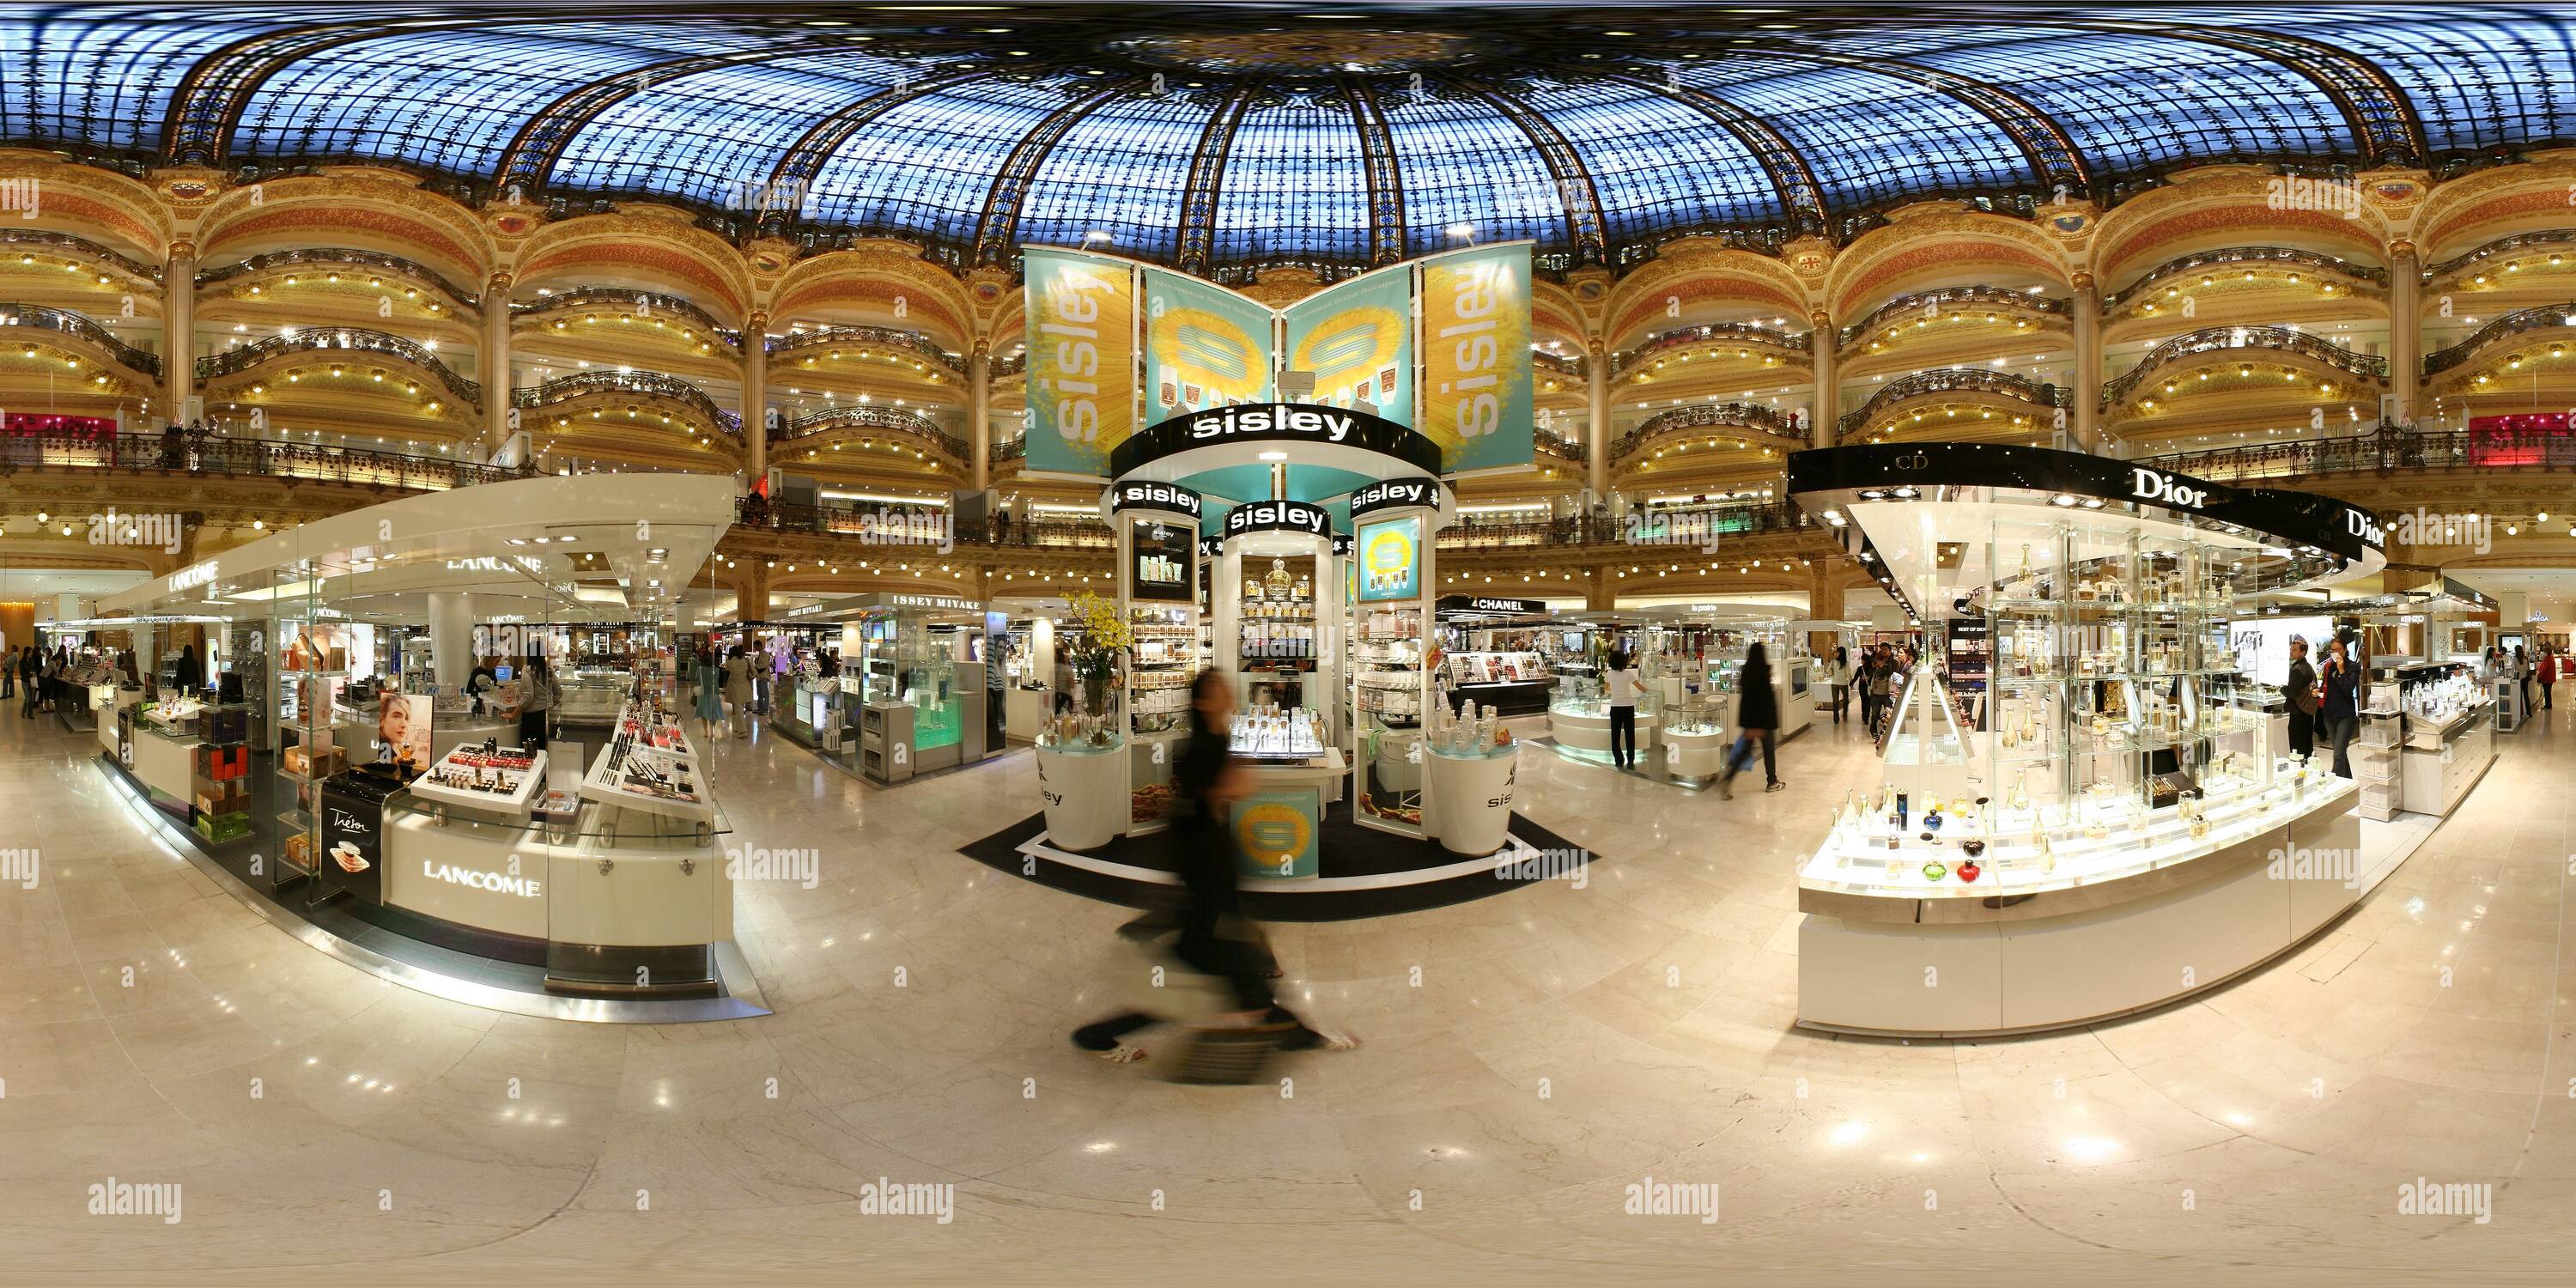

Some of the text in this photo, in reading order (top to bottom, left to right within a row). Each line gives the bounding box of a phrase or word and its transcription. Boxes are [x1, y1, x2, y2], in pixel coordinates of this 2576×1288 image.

[1041, 266, 1115, 441] sisley
[1193, 405, 1352, 441] sisley
[1895, 456, 1929, 470] CD
[1126, 485, 1200, 516] sisley
[1352, 483, 1424, 511] sisley
[2133, 468, 2207, 508] Dior
[1230, 502, 1323, 533] sisley
[2346, 508, 2385, 548] Dior
[169, 561, 219, 592] LANCÔME
[487, 614, 525, 623] LANCÔME
[802, 605, 823, 616] MIYAKE
[893, 595, 980, 611] ISSEY MIYAKE
[1479, 599, 1524, 611] CHANEL
[330, 807, 369, 834] Trésor
[422, 860, 542, 898] LANCÔME
